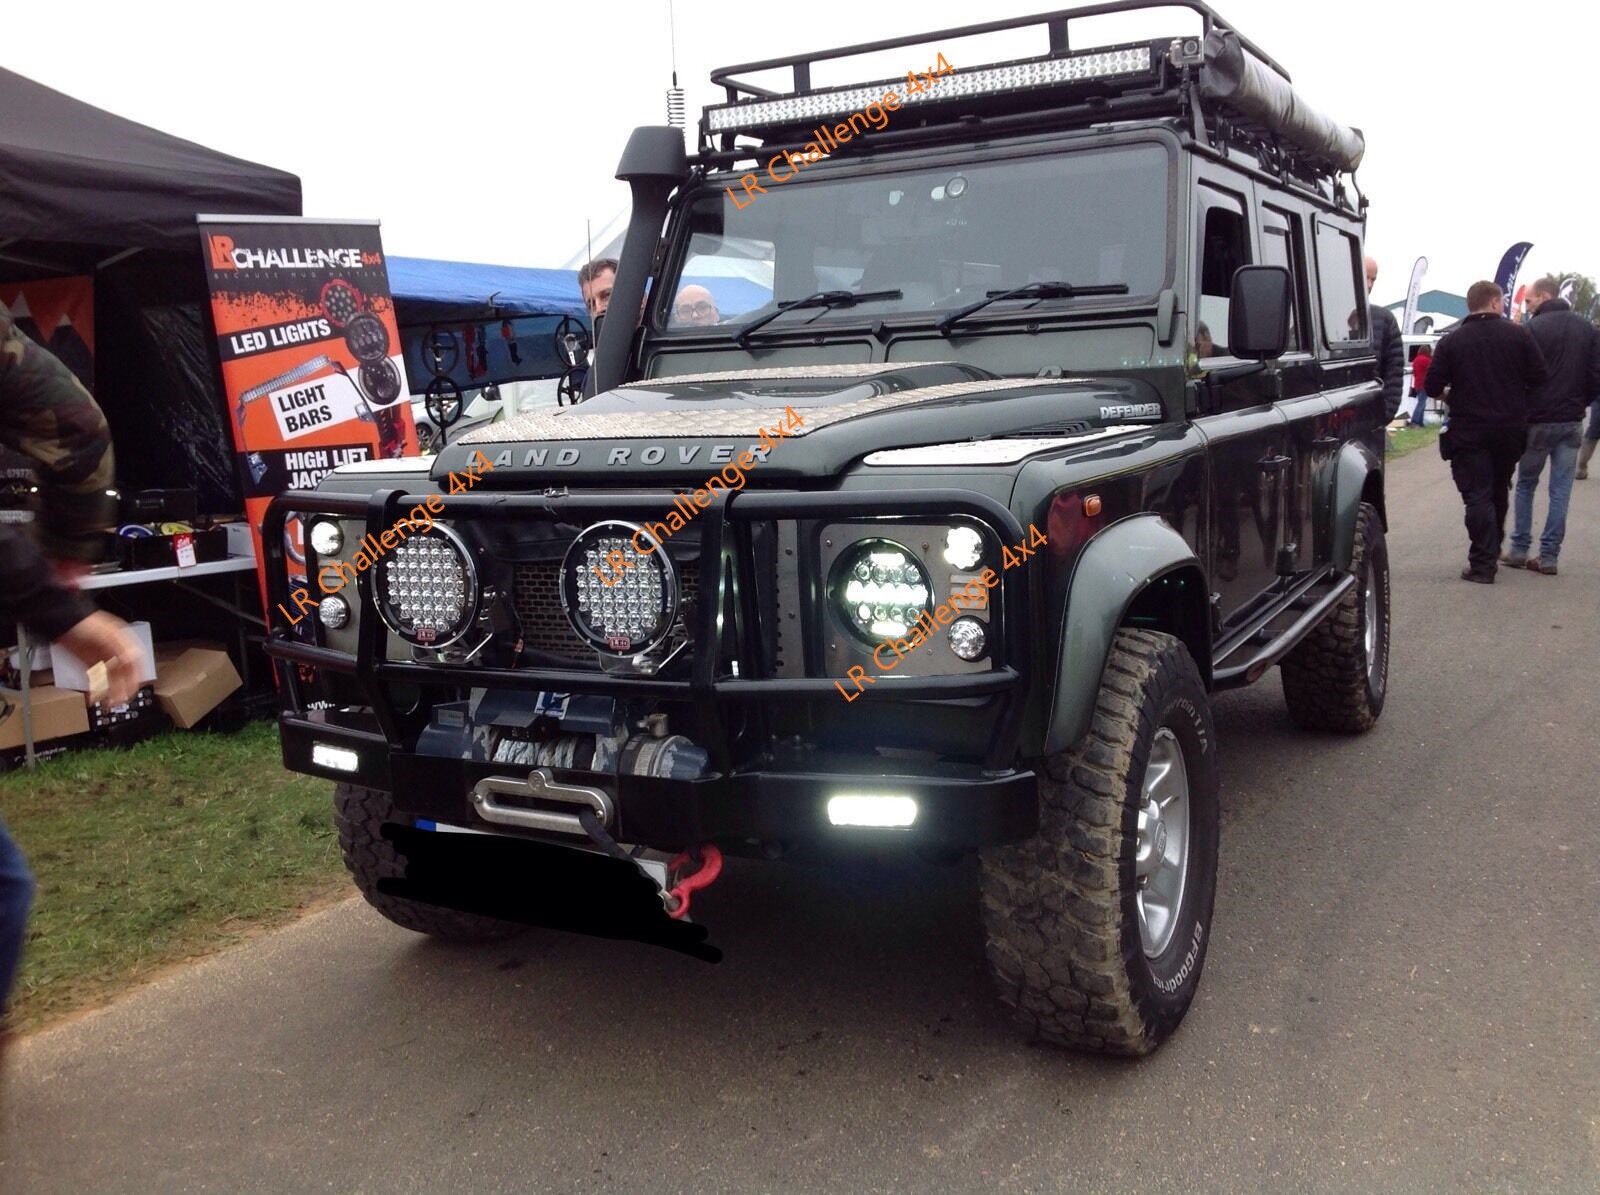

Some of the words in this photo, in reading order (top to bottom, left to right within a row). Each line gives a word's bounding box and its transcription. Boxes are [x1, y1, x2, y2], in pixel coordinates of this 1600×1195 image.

[214, 272, 279, 280] BECAUSE
[230, 331, 267, 355] LED
[270, 318, 331, 346] LIGHTS
[277, 384, 326, 412] LIGHT
[285, 405, 333, 434] BARS
[1100, 402, 1161, 419] DEFENDER
[285, 450, 329, 470] HIGH
[332, 447, 368, 466] LIFT
[464, 448, 580, 468] LAND
[607, 444, 772, 465] ROVER
